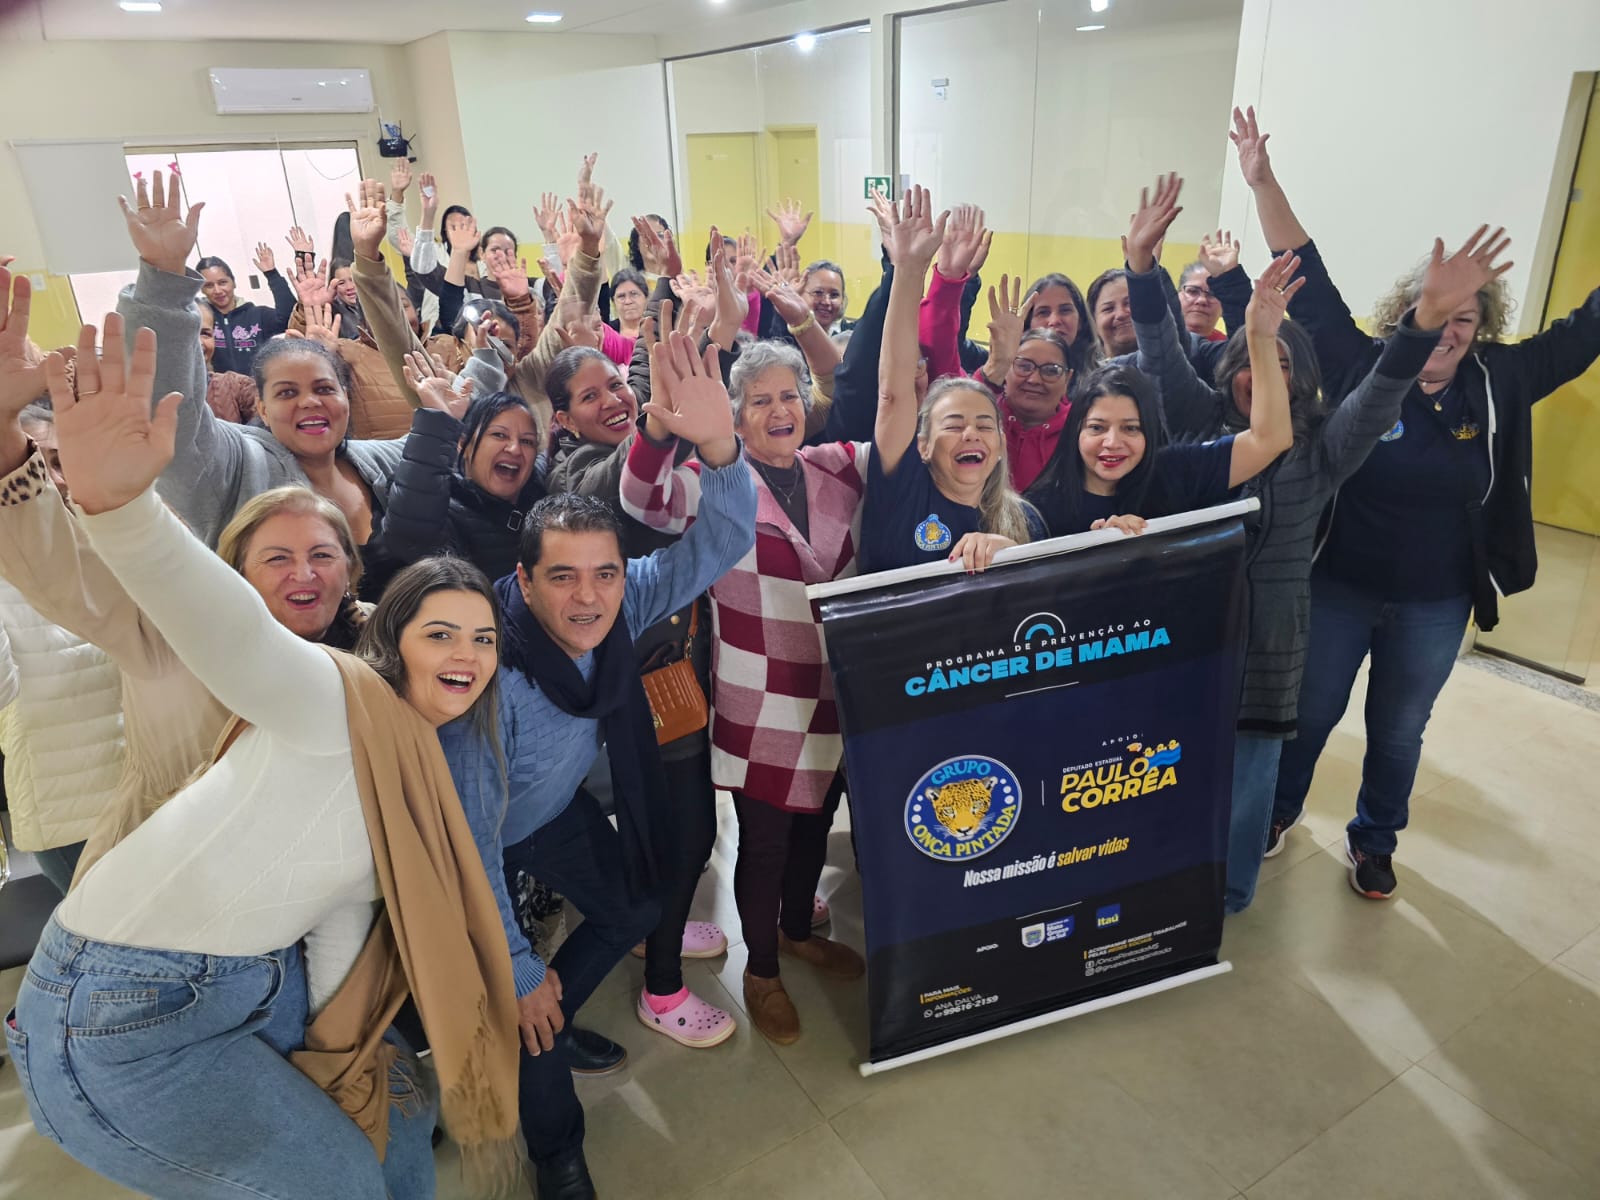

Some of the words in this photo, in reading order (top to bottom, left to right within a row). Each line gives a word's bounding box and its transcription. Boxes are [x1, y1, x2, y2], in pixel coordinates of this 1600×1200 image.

[904, 656, 1030, 697] CÂNCER
[1035, 647, 1073, 671] DE
[1078, 627, 1171, 662] MAMA
[926, 648, 1005, 670] PROGRAMA
[1014, 642, 1031, 652] DE
[1041, 624, 1124, 647] PREVENÇÃO
[1133, 619, 1151, 629] AO
[931, 760, 991, 785] GRUPO
[1060, 757, 1150, 794] PAULO
[1062, 762, 1093, 773] DEPUTADO
[1094, 755, 1123, 767] ESTADUAL
[1061, 766, 1177, 813] CORRÊA
[913, 824, 952, 857] ONÇA
[956, 804, 1017, 856] PINTADA
[963, 867, 1002, 888] Nossa
[1002, 854, 1046, 879] missão
[1047, 851, 1056, 868] é
[1056, 845, 1097, 867] salvar
[1097, 836, 1130, 857] vidas
[1097, 913, 1119, 927] Itaú
[934, 1001, 954, 1011] ANA
[954, 994, 982, 1005] DALVA
